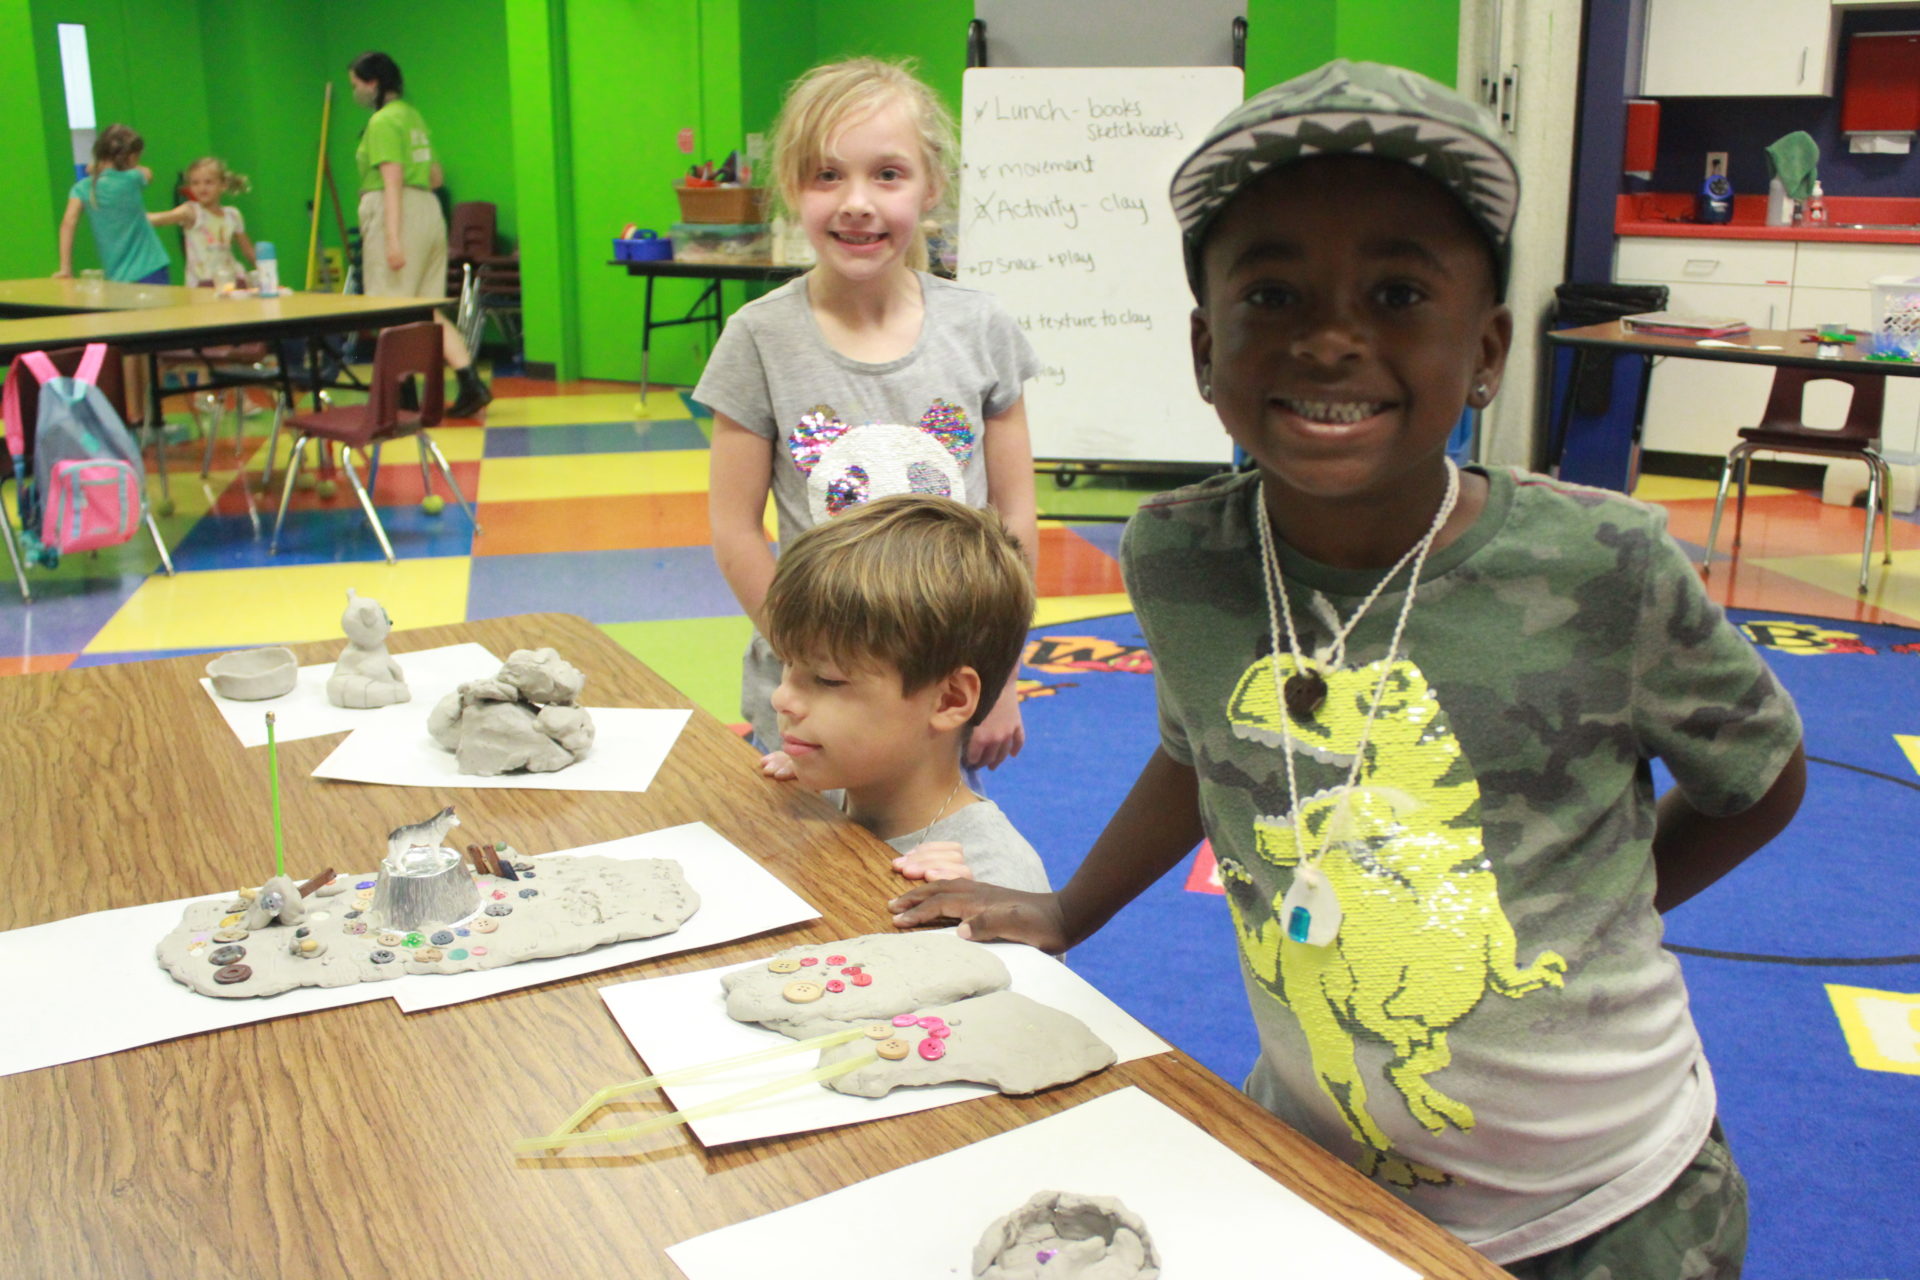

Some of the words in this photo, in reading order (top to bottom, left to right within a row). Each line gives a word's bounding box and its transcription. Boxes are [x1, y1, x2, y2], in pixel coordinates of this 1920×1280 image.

[1087, 97, 1142, 118] books
[1099, 193, 1149, 225] clay
[1037, 312, 1098, 329] texture
[1101, 309, 1118, 327] to
[1119, 309, 1153, 331] clay
